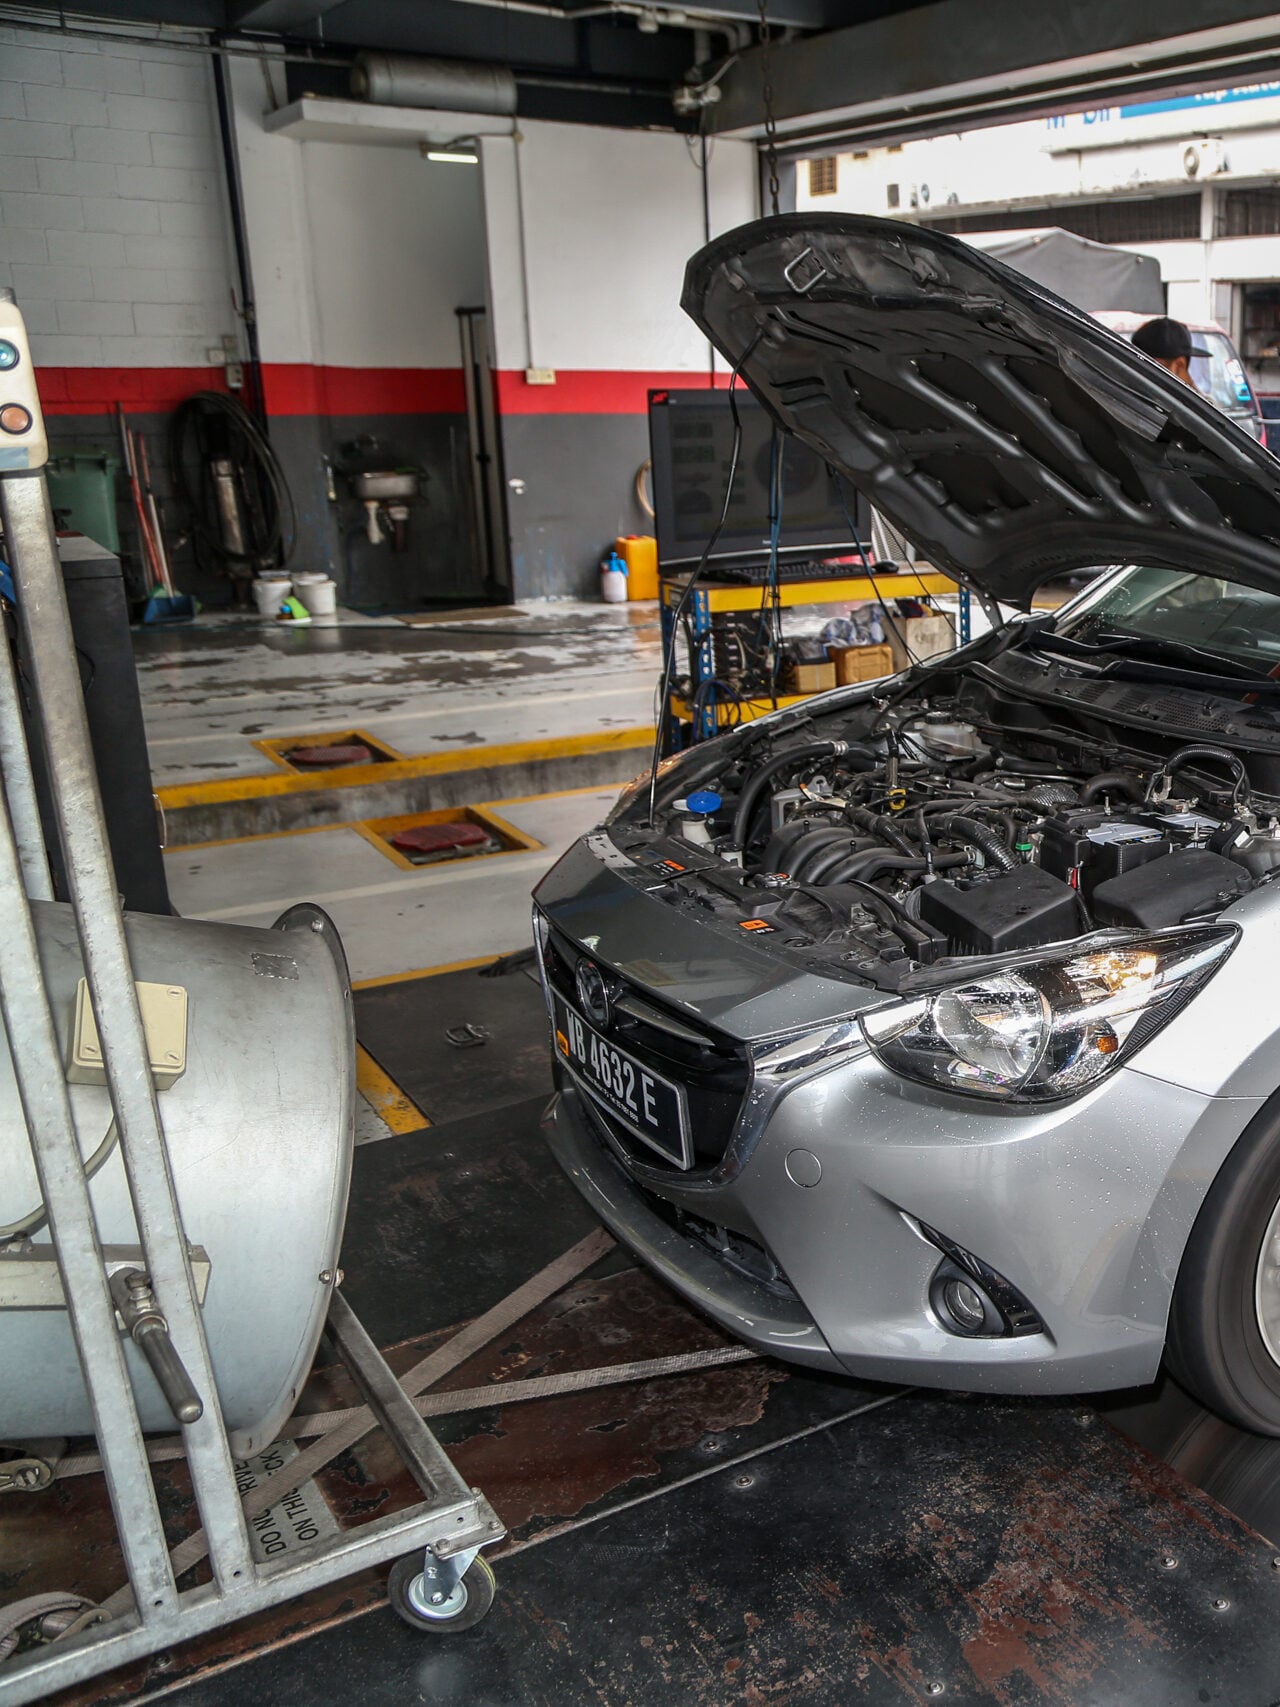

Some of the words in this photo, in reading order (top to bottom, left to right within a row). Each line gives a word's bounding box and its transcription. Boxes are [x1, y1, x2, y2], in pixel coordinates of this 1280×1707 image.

[566, 1007, 586, 1064] WB
[590, 1034, 638, 1111] 4632
[641, 1072, 658, 1127] E
[234, 1460, 258, 1498] RIVE
[260, 1530, 287, 1555] DO
[292, 1517, 319, 1541] ON
